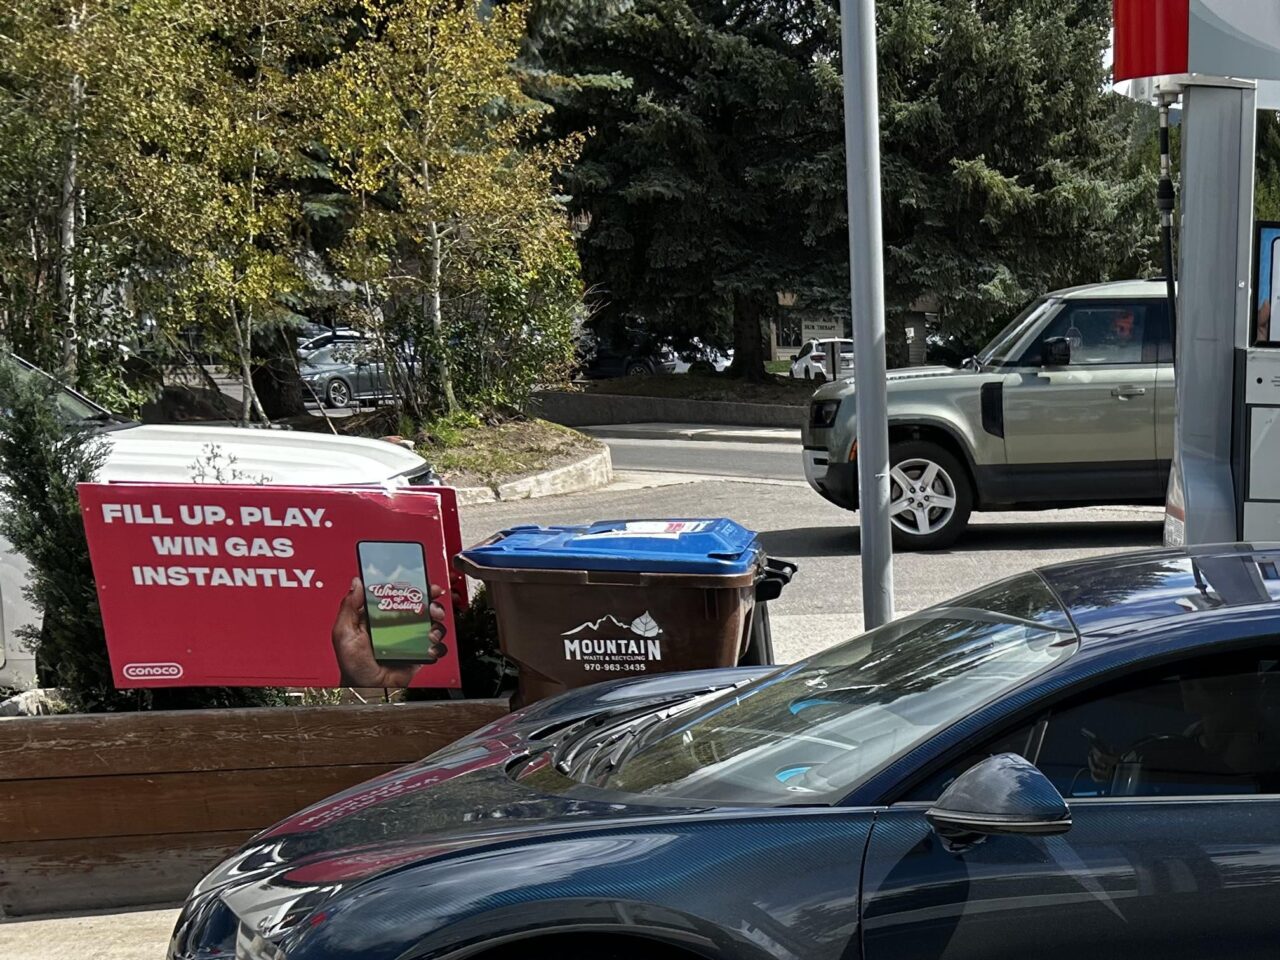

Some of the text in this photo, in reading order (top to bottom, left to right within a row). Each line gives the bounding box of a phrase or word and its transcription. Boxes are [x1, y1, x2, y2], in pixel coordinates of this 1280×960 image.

[101, 504, 333, 528] FILL UP. PLAY.
[151, 536, 295, 558] WIN GAS
[132, 565, 324, 589] INSTANTLY.
[368, 583, 409, 597] Wheel
[378, 598, 423, 614] Destiny
[563, 639, 661, 661] MOUNTAIN
[128, 666, 178, 675] conoco
[584, 663, 646, 671] 970-963-3435
